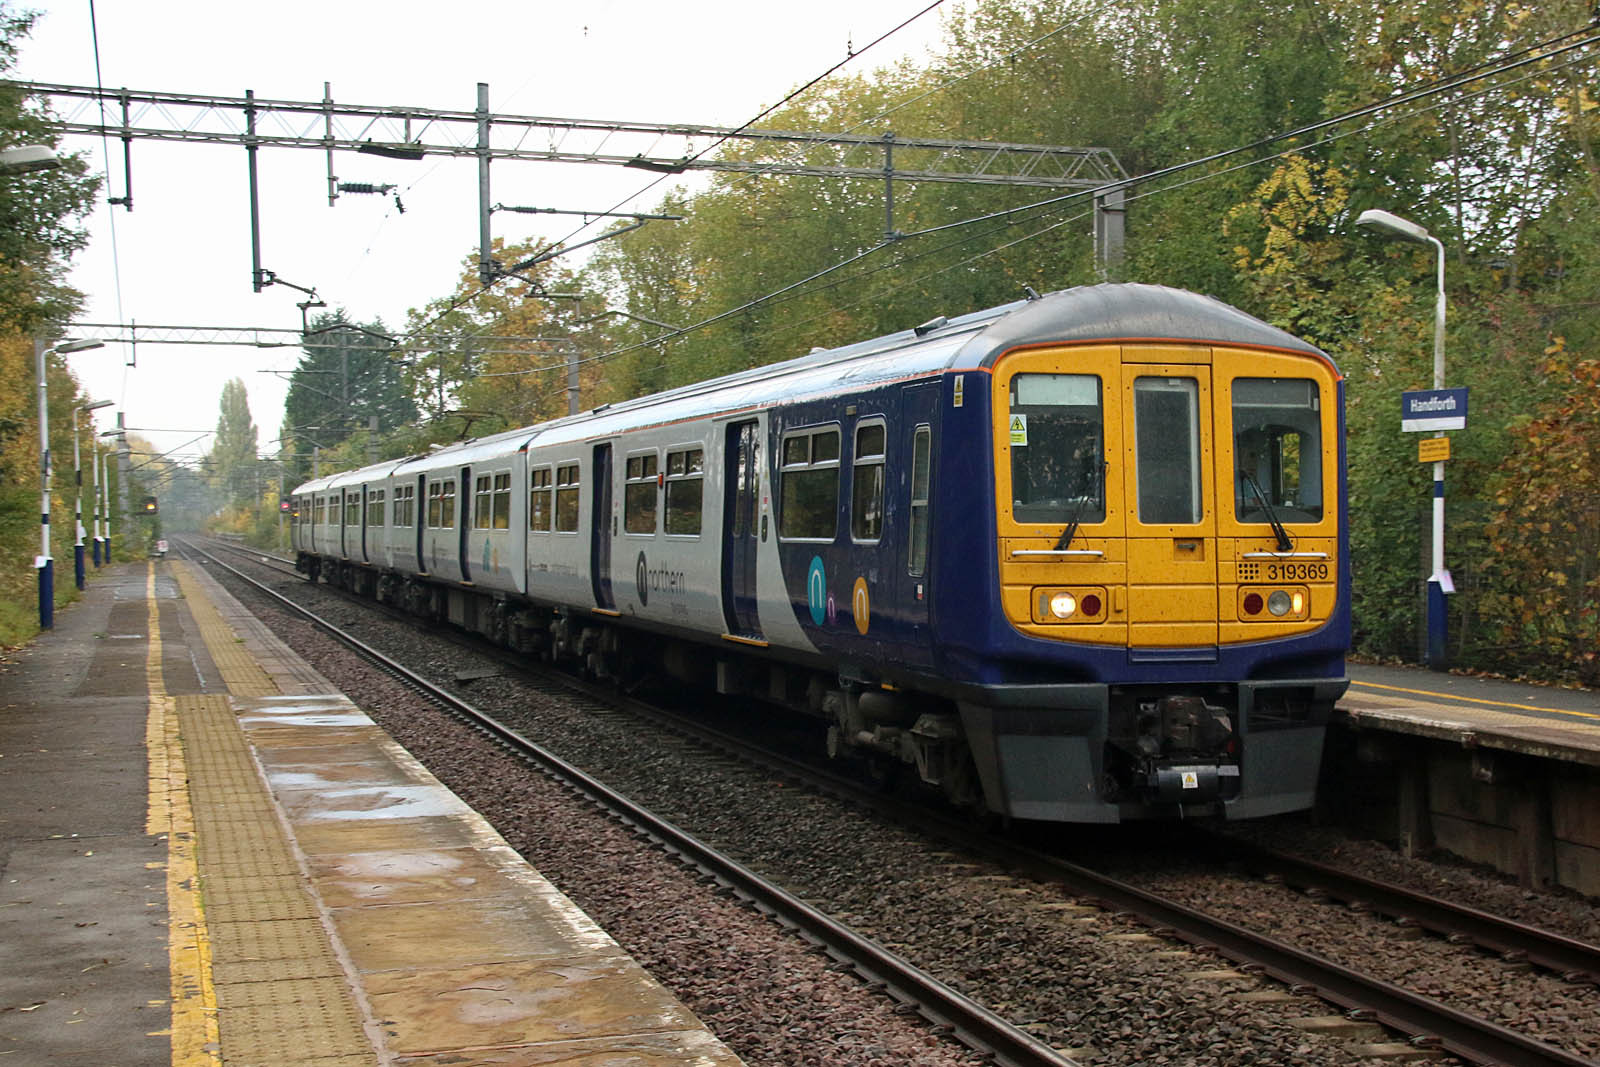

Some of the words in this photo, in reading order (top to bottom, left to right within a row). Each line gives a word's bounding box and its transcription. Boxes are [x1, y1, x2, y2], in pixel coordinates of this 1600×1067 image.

[1410, 396, 1456, 412] Handforth
[648, 560, 685, 595] northern
[1268, 564, 1328, 580] 319369
